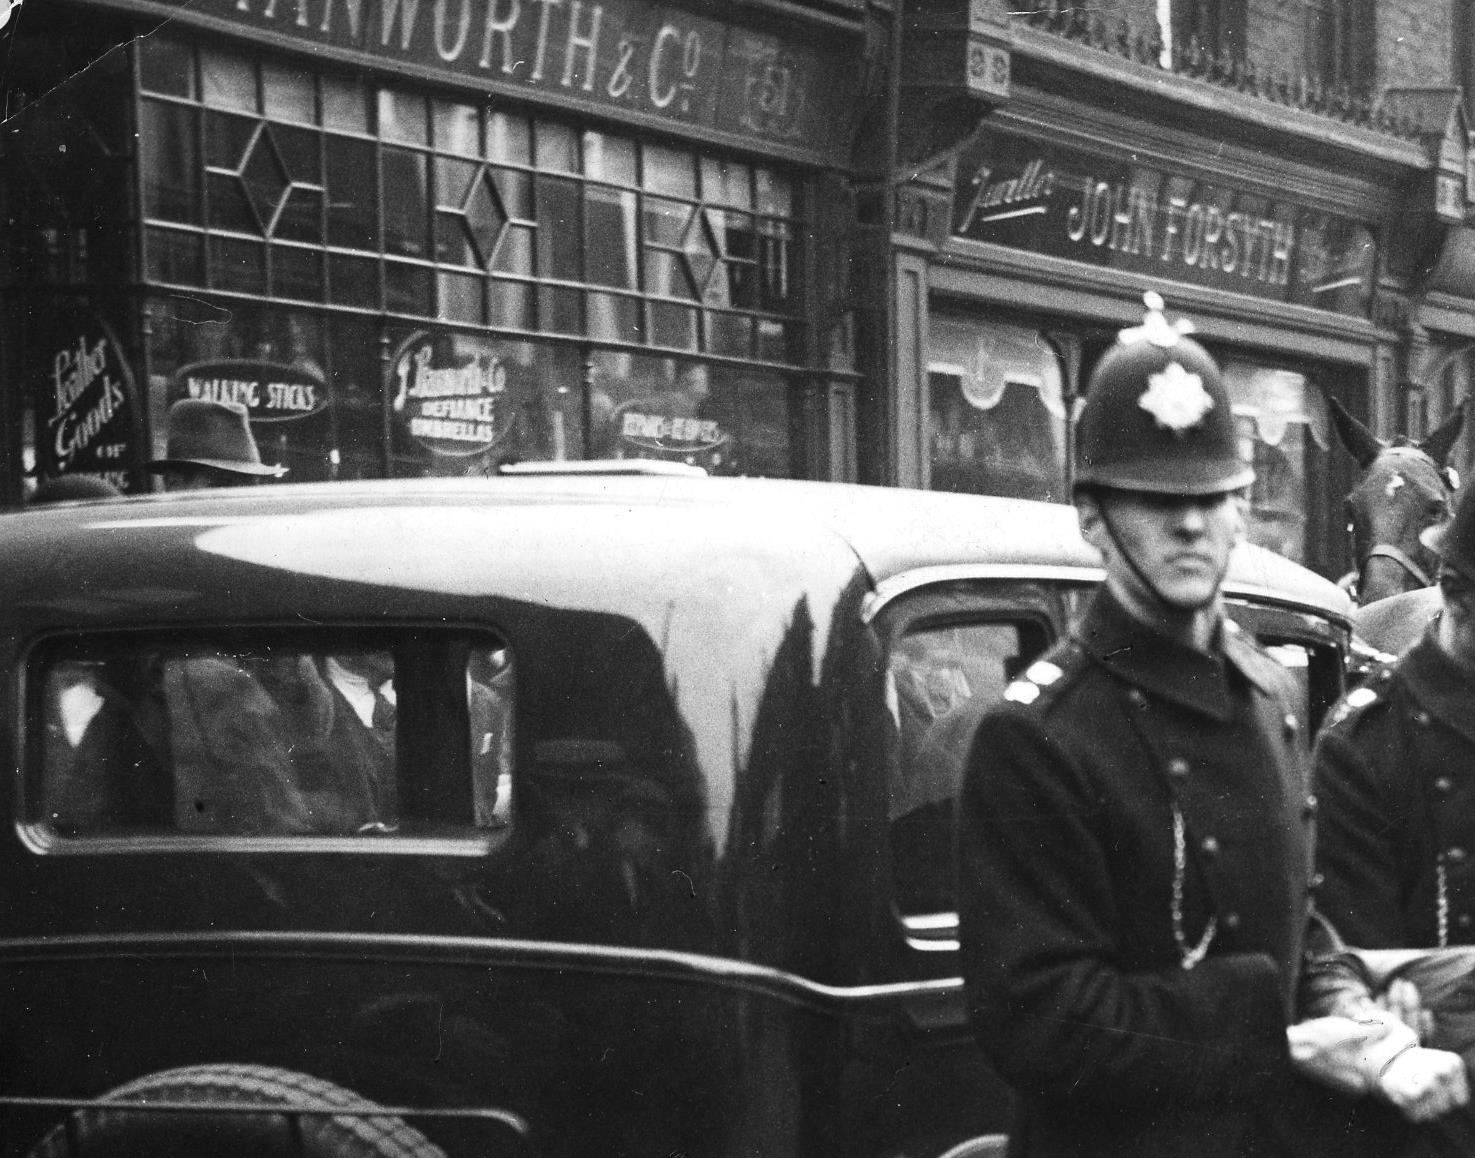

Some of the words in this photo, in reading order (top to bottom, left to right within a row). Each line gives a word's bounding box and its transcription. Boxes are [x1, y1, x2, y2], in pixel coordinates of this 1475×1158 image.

[1067, 176, 1157, 257] JOHN
[1160, 198, 1295, 285] FORSYTH
[55, 375, 125, 471] Goods
[265, 381, 315, 411] STICKS
